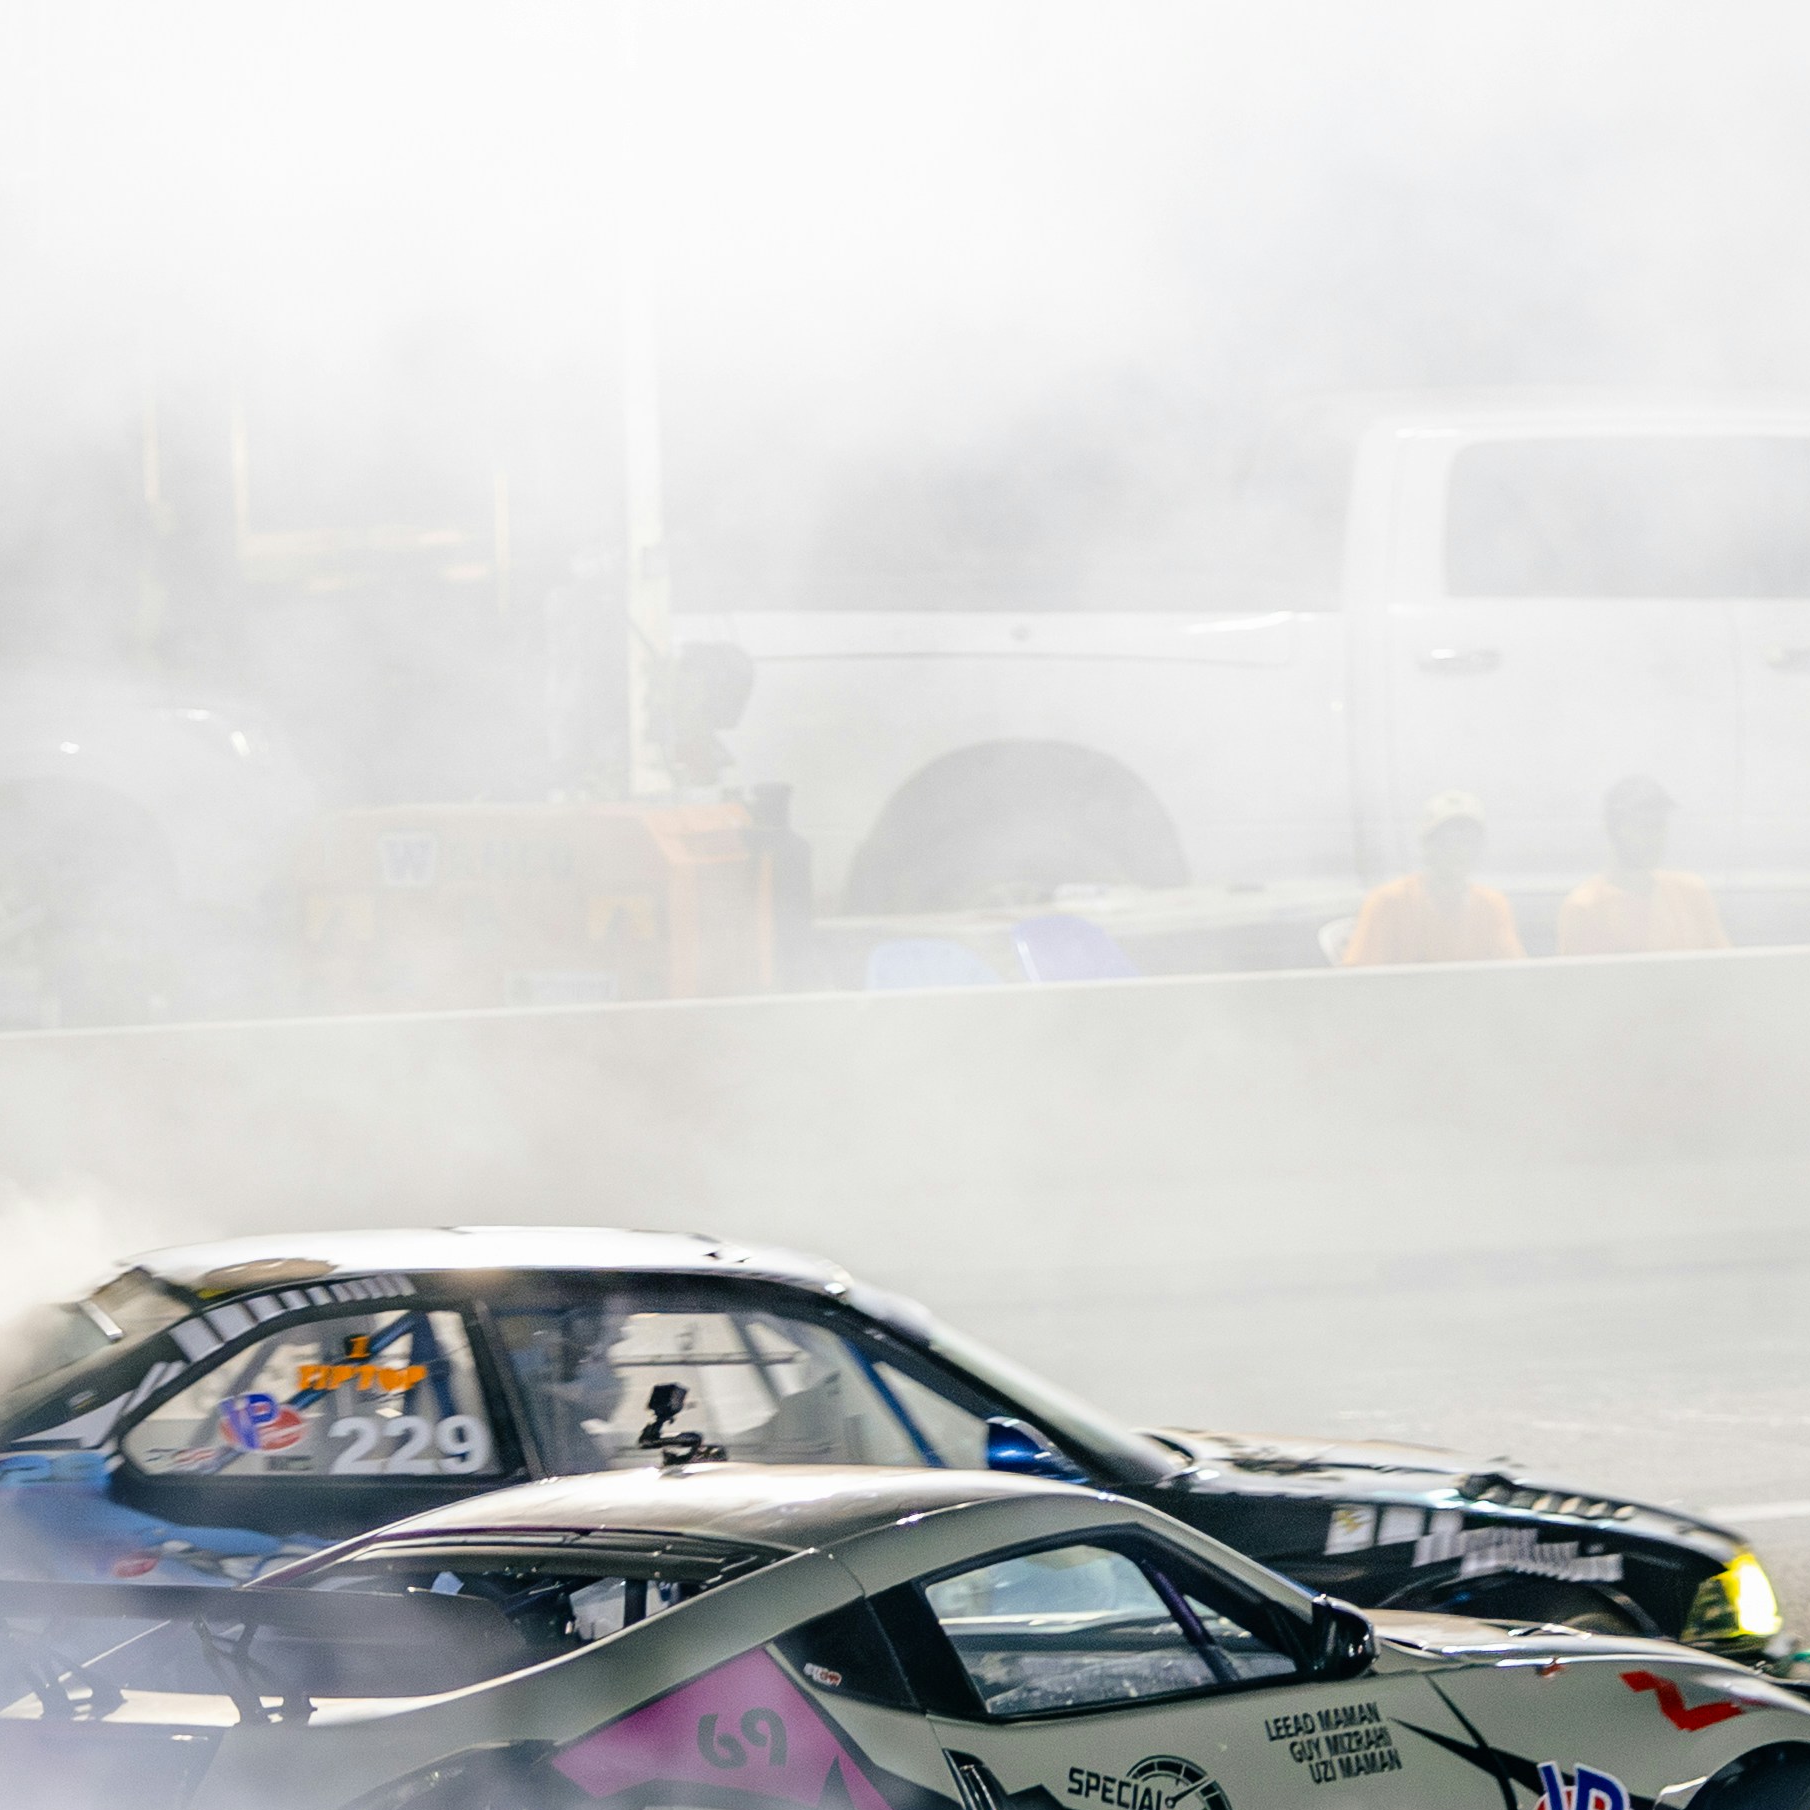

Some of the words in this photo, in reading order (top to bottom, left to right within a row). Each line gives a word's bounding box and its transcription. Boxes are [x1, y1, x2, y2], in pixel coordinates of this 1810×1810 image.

[328, 1415, 489, 1475] 229
[1317, 1702, 1381, 1732] MAMAN
[696, 1707, 787, 1770] 69
[1290, 1737, 1322, 1763] GUY
[1309, 1760, 1337, 1784] UZI
[1338, 1748, 1403, 1779] MAMAN
